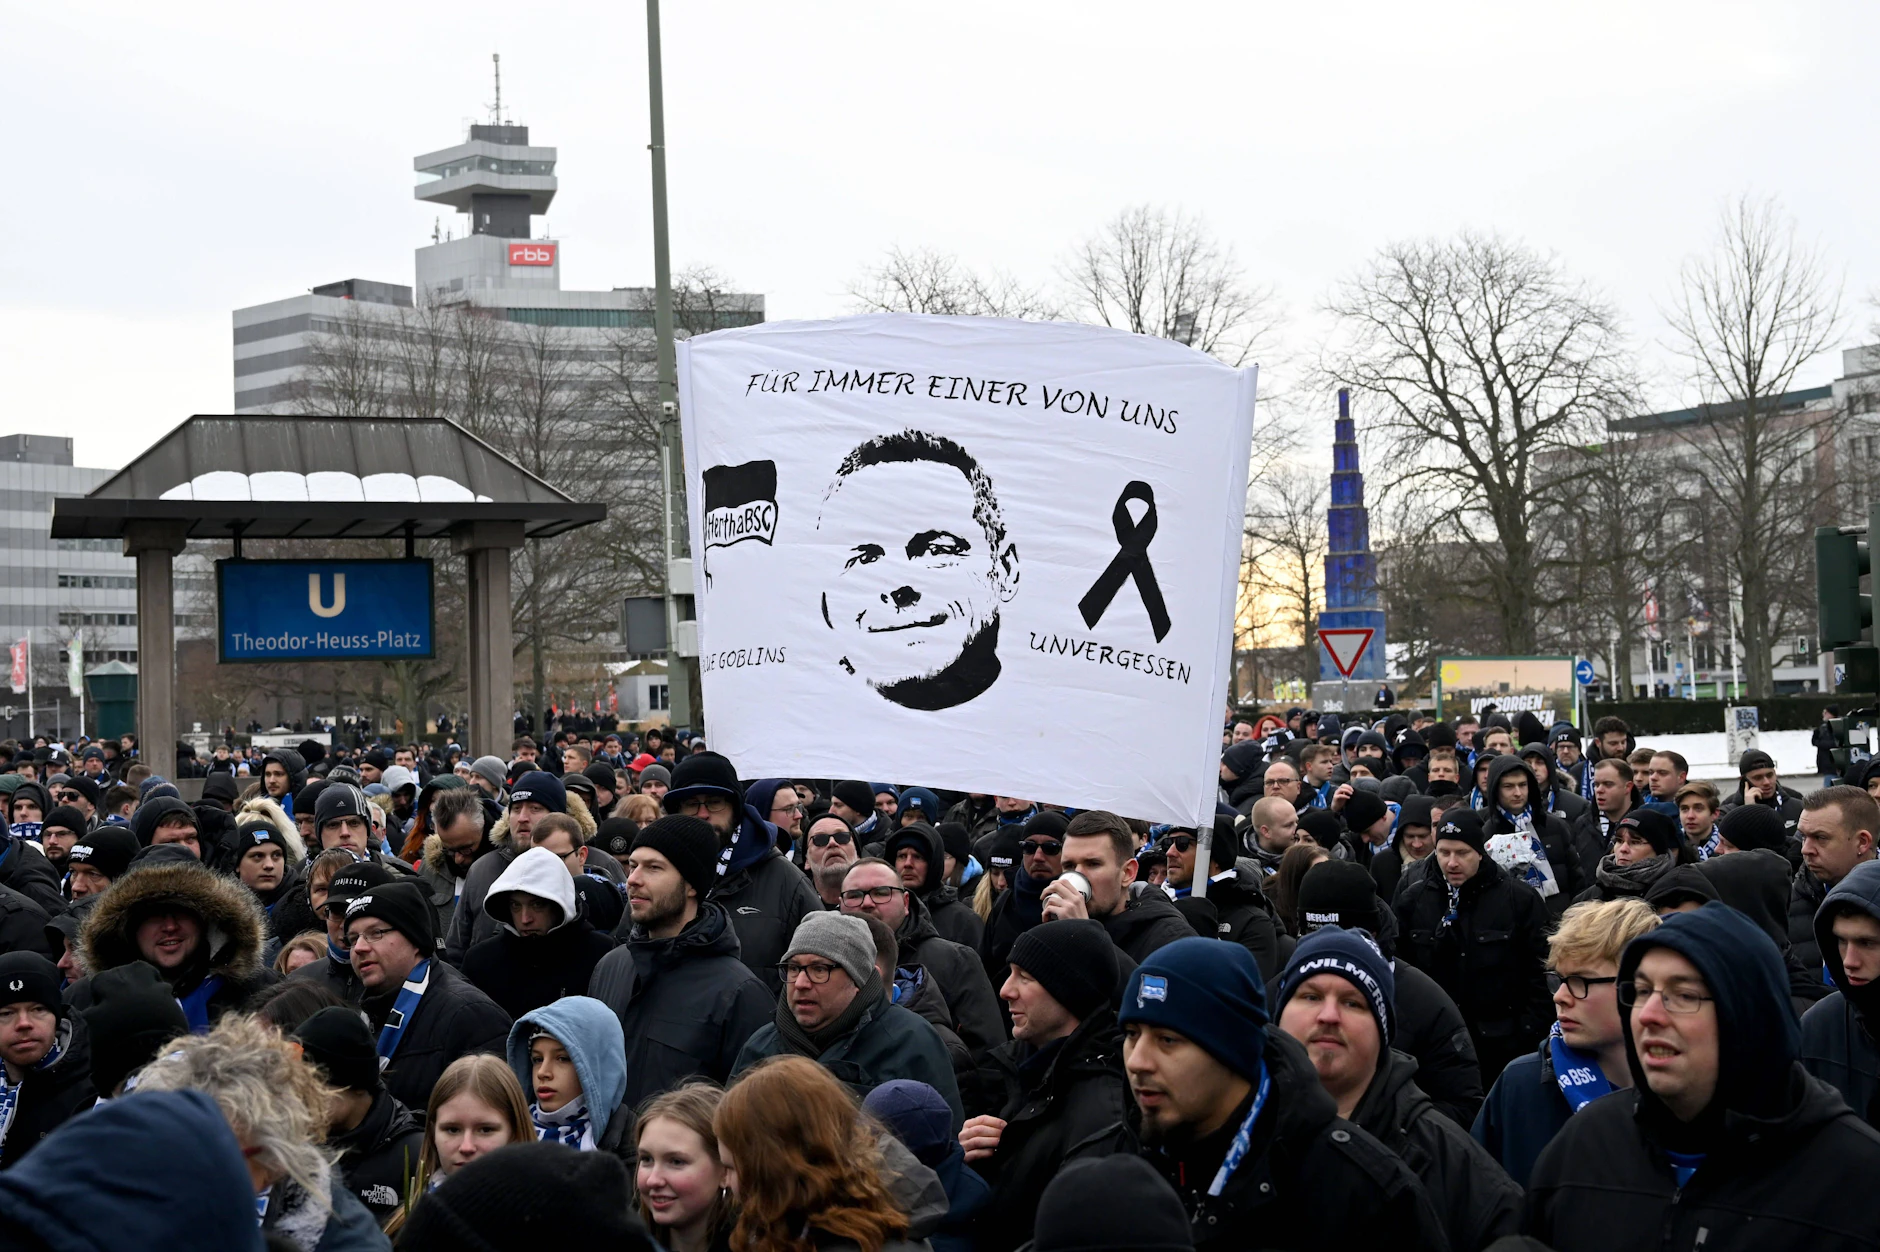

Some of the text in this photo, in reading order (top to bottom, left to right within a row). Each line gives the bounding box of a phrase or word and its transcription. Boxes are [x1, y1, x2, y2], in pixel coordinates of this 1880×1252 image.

[513, 248, 550, 262] rbb
[745, 369, 1179, 434] FÜR IMMER EINER VON UNS
[308, 573, 346, 618] U
[231, 630, 421, 651] Theodor-Heuss-Platz
[719, 647, 786, 669] GOBLINS
[1030, 631, 1191, 685] UNVERGESSEN
[1558, 734, 1569, 742] NY
[1305, 912, 1339, 923] BERLIN
[1567, 1066, 1597, 1086] BSC
[361, 1190, 386, 1199] NORTH
[373, 1184, 386, 1192] THE
[368, 1197, 386, 1205] FACE
